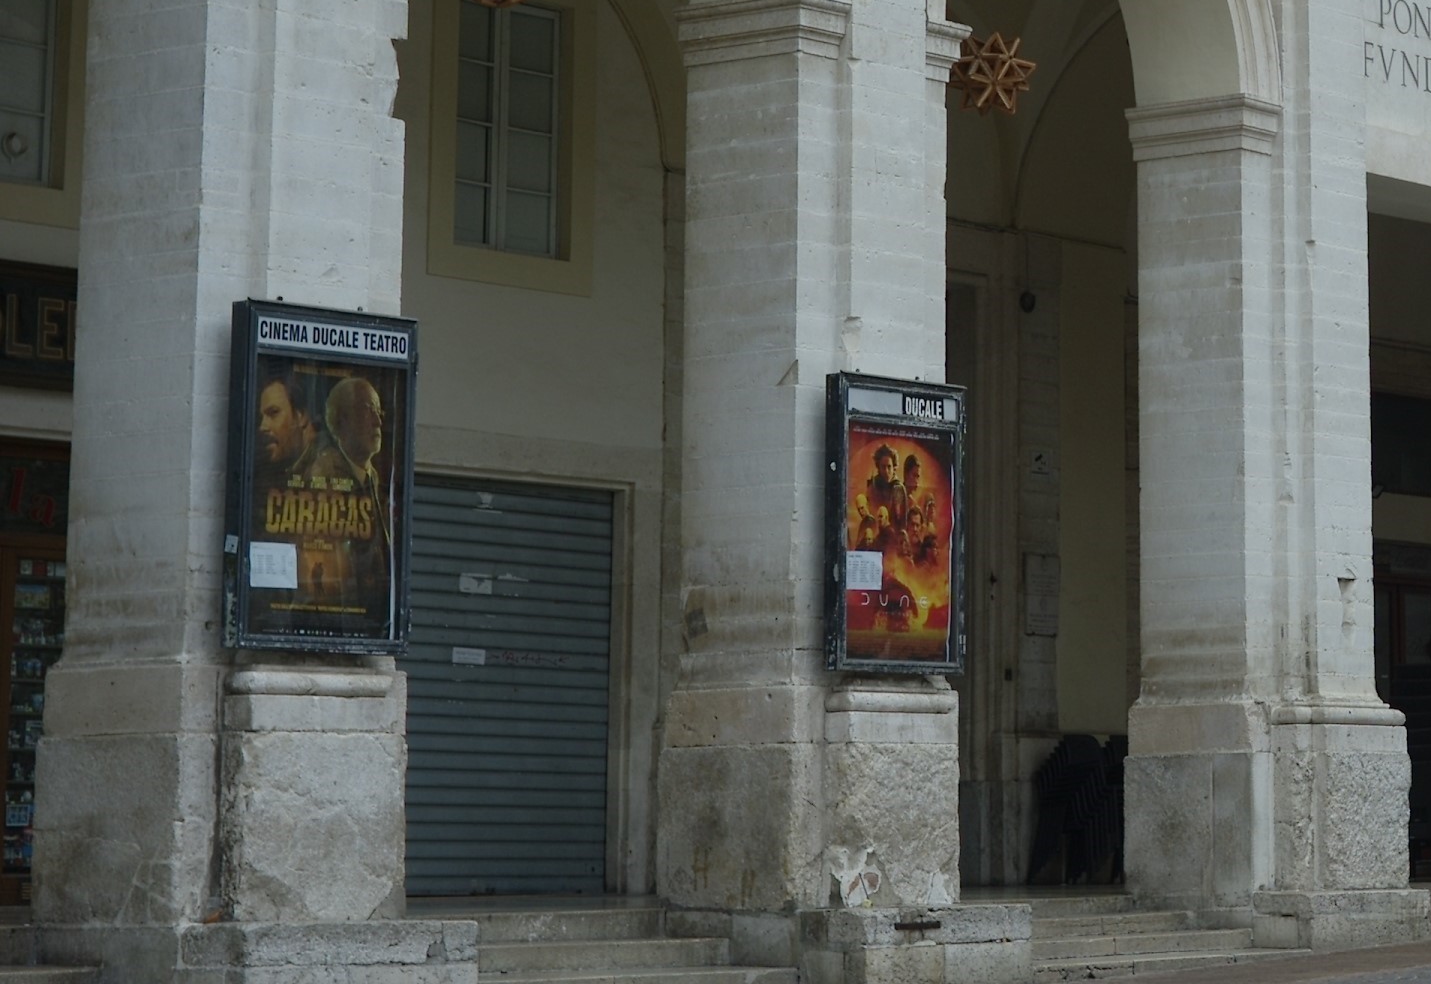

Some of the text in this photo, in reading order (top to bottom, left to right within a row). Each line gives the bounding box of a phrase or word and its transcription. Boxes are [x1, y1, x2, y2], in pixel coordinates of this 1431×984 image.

[260, 320, 407, 355] CINEMA DUCALE TEATRO
[904, 395, 943, 421] DUCALE
[265, 488, 372, 541] CARACAS
